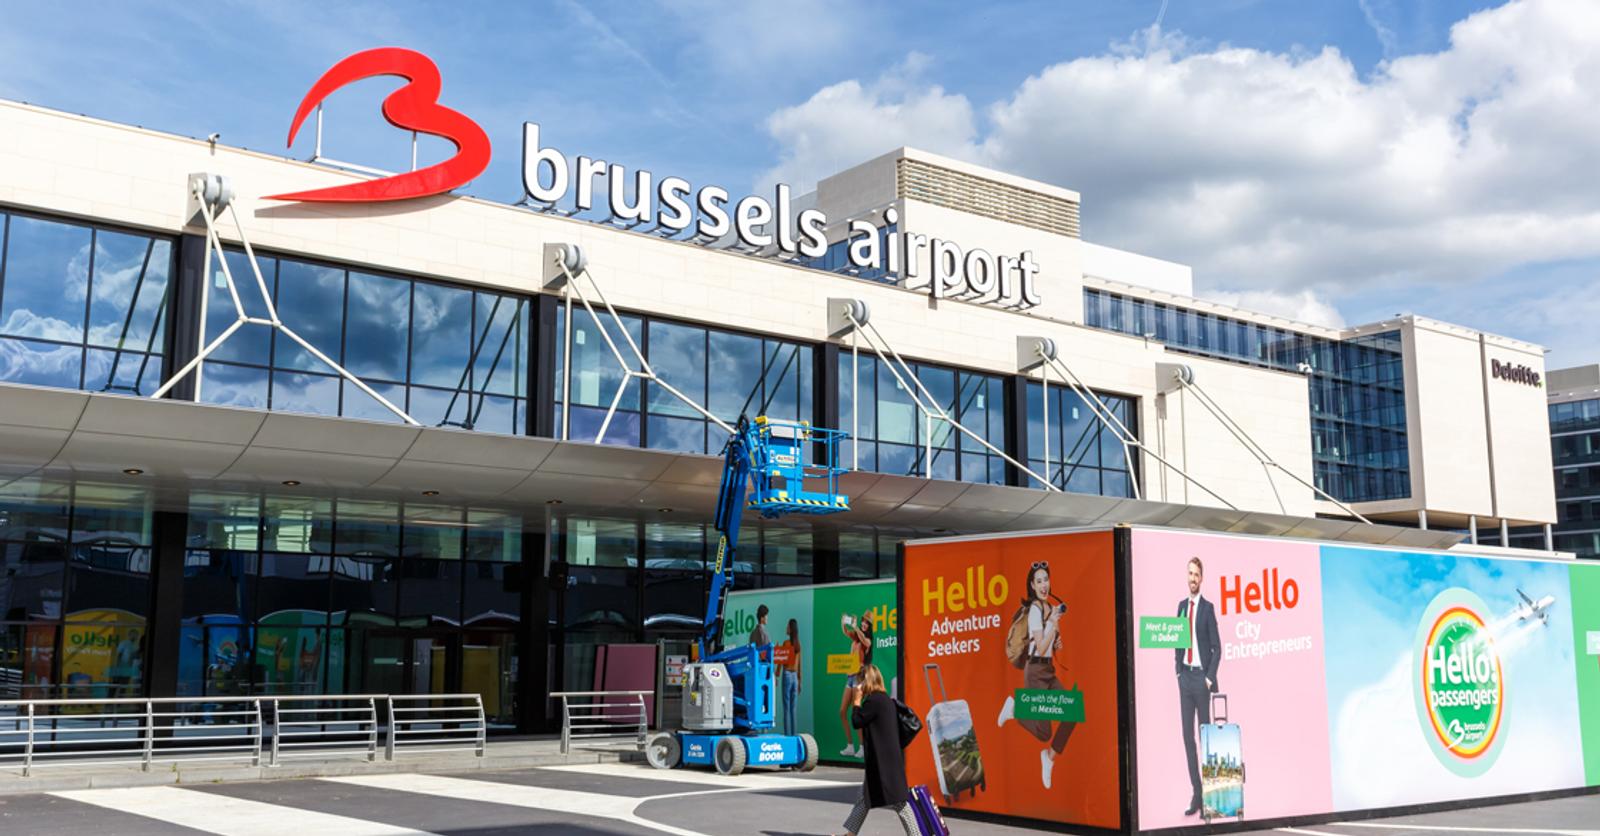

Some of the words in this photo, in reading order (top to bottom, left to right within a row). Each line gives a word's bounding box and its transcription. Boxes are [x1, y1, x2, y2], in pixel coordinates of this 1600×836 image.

[521, 121, 828, 258] brussels
[848, 208, 1042, 306] airport
[922, 565, 1009, 616] Hello
[1220, 567, 1299, 616] Hello
[724, 609, 755, 636] ello
[930, 613, 1001, 636] Adventure
[1145, 622, 1161, 631] Meet
[1167, 623, 1184, 633] greet
[1235, 620, 1261, 641] City
[928, 637, 981, 658] Seekers
[1224, 635, 1313, 661] Entrepreneurs
[1427, 640, 1498, 685] Hello!
[1020, 693, 1030, 704] Go
[1030, 694, 1045, 704] with
[1046, 694, 1057, 704] the
[1057, 694, 1075, 706] flow
[1030, 704, 1038, 713] in
[1038, 705, 1065, 715] Mexico.
[1430, 689, 1499, 711] passengers
[1463, 722, 1486, 732] brussels
[1464, 730, 1483, 742] airport
[759, 752, 783, 762] BOOM
